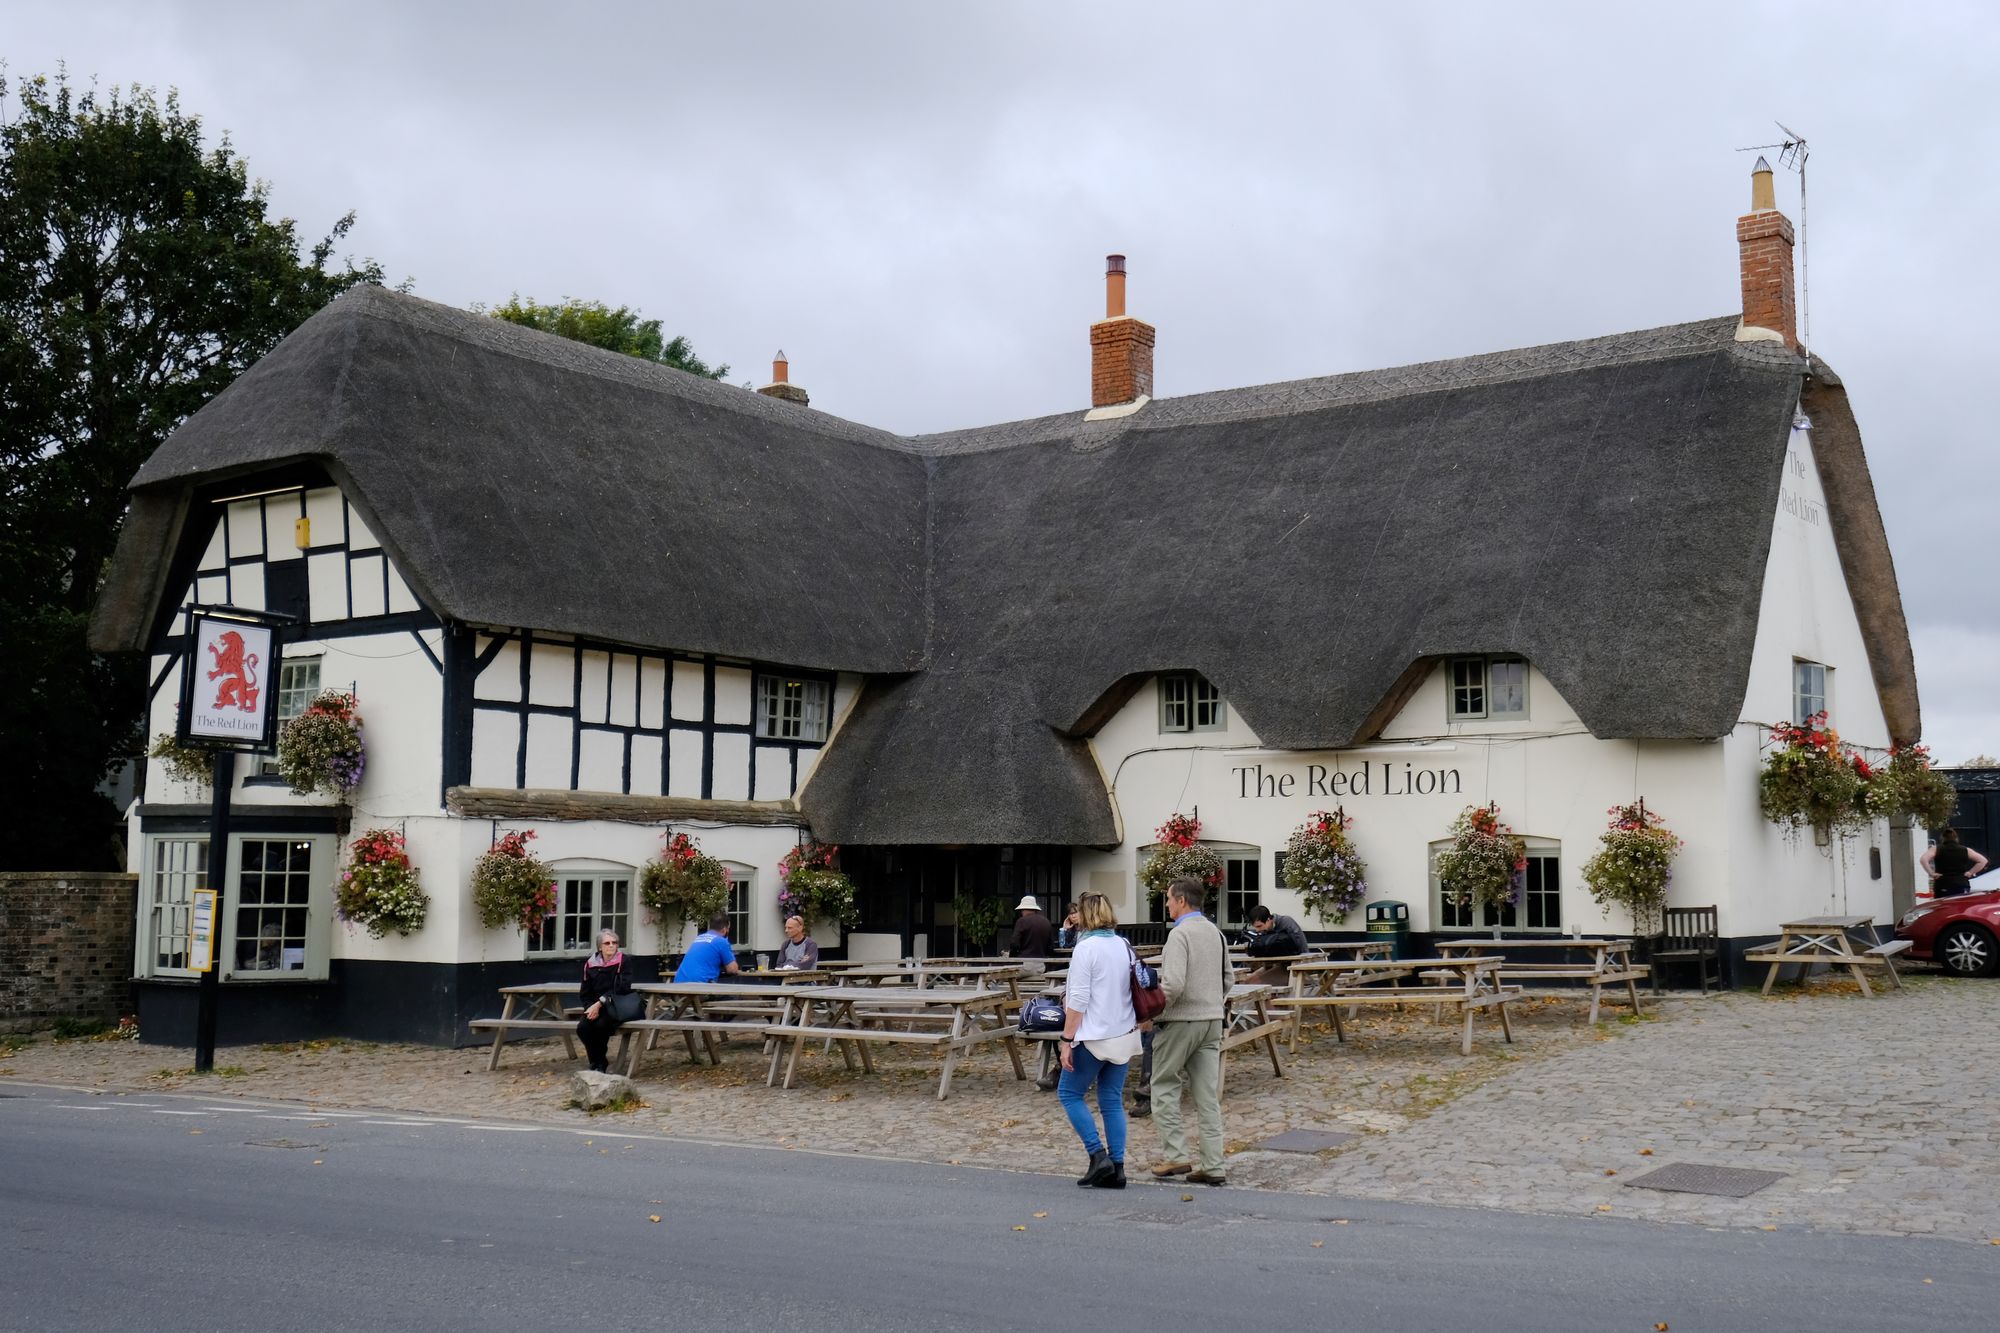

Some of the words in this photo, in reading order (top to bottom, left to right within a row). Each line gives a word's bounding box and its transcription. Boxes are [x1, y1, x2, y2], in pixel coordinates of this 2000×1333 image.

[1788, 450, 1806, 480] The
[1782, 487, 1798, 518] Red
[1799, 496, 1819, 526] Lion
[196, 715, 215, 727] The
[217, 717, 235, 729] Red
[237, 719, 258, 731] Lion
[1232, 764, 1295, 799] The
[1306, 761, 1372, 797] Red
[1382, 762, 1463, 796] Lion
